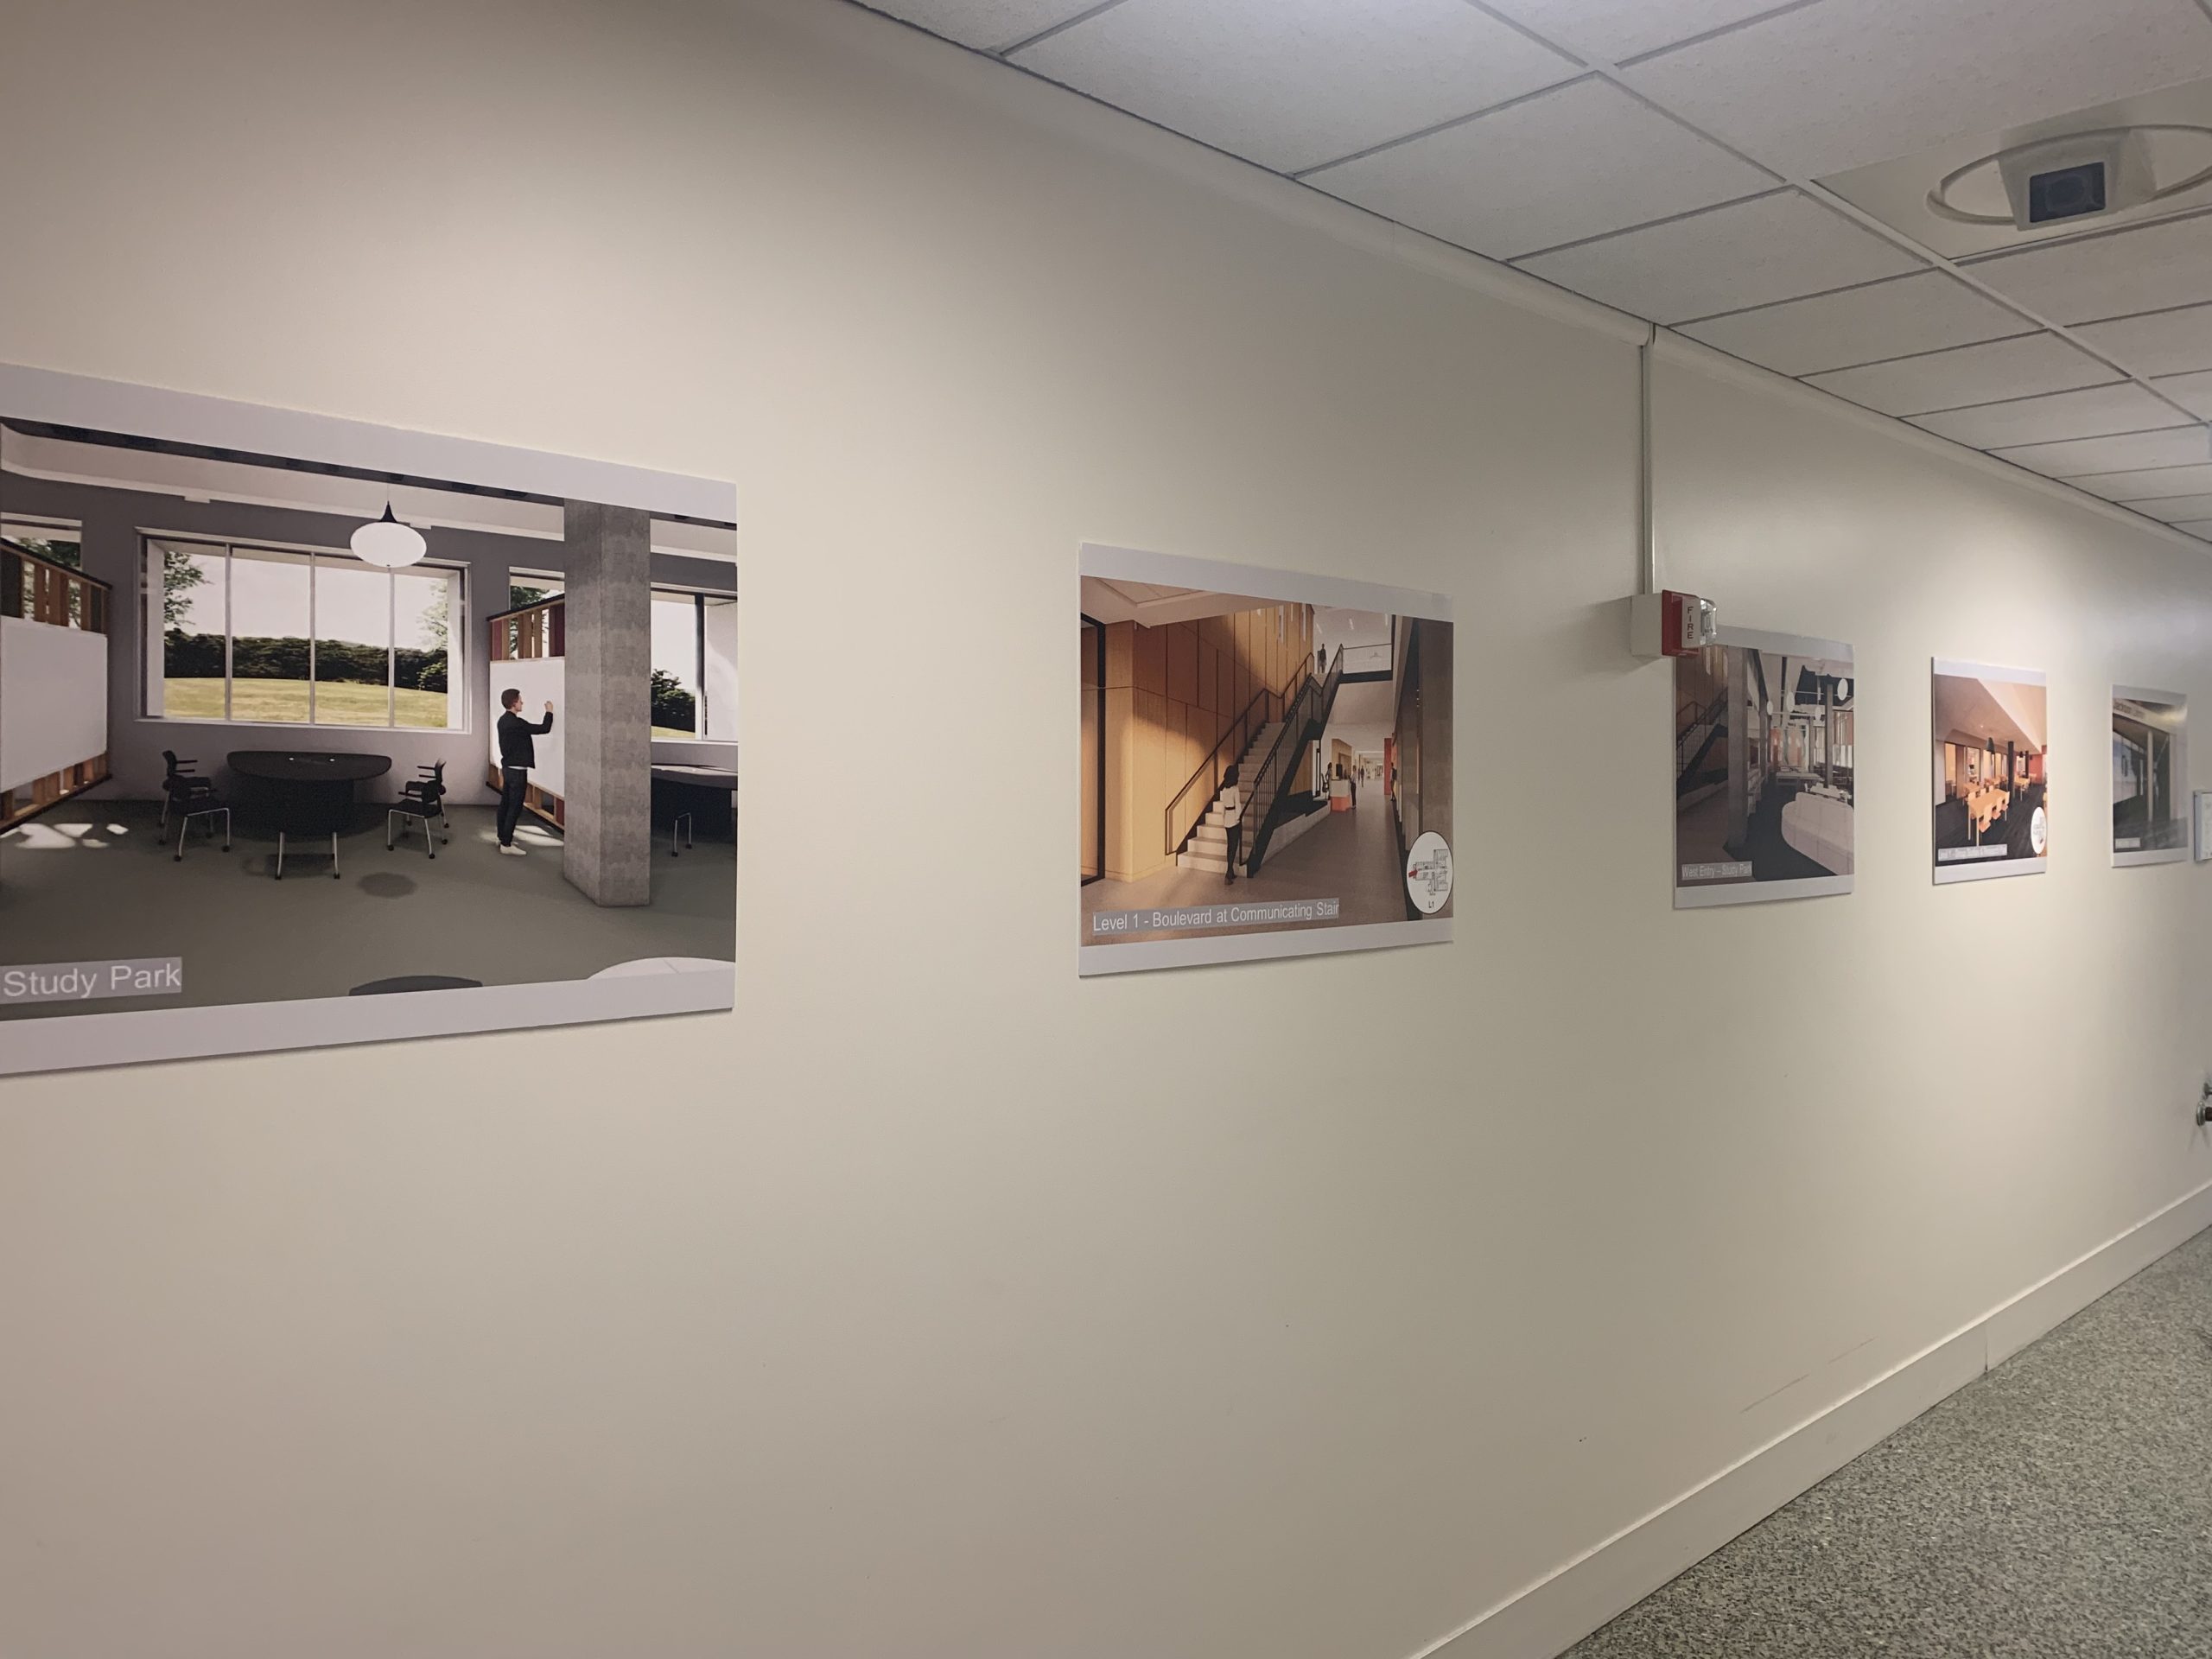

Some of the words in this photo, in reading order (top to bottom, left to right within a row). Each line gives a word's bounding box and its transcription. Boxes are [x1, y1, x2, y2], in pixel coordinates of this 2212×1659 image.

[1092, 912, 1128, 932] Level
[1133, 913, 1140, 929] 1
[1153, 907, 1212, 928] Boulevard
[1217, 909, 1229, 924] at
[1231, 902, 1313, 923] Communicating
[1316, 899, 1339, 917] Stair
[3, 967, 97, 999] Study
[110, 963, 181, 991] Park
